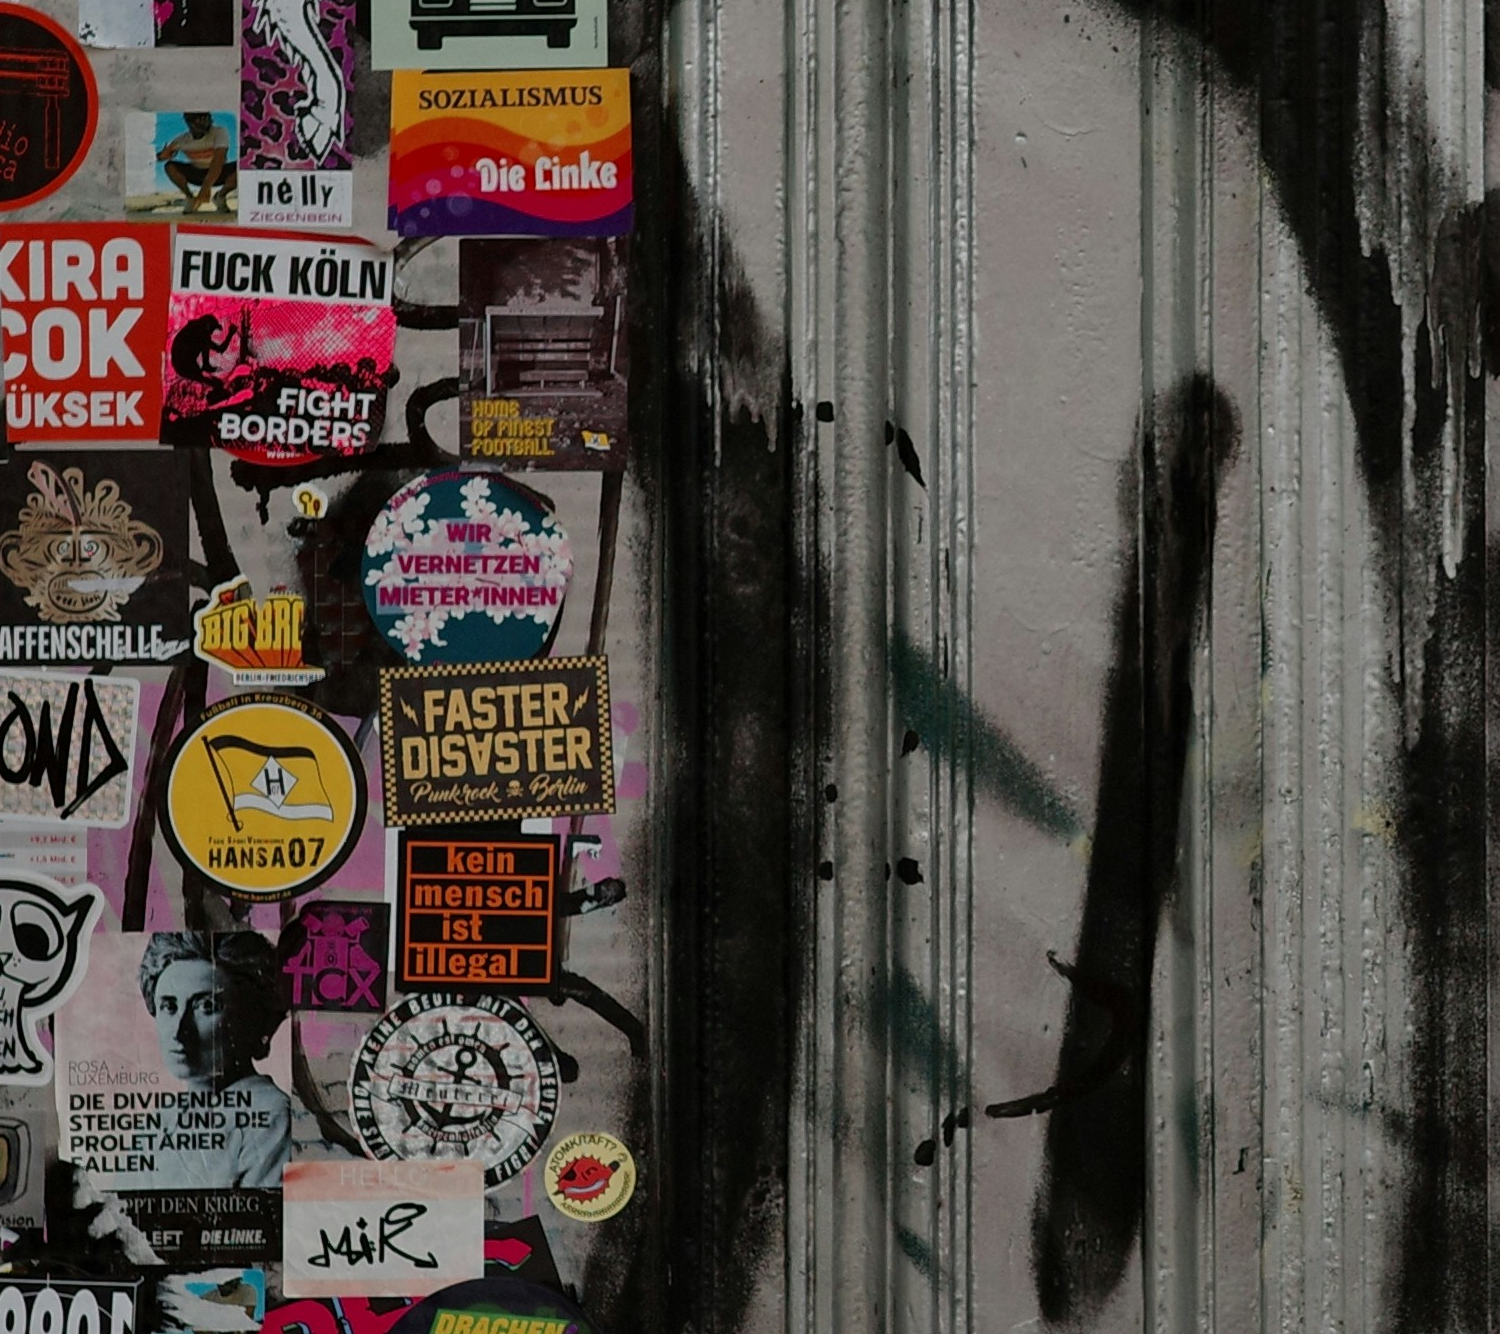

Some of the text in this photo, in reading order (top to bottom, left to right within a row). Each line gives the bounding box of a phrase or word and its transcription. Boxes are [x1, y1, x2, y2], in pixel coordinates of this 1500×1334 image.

[419, 86, 603, 110] SOZIALISMUS
[180, 248, 387, 299] FUCK KÖLN
[277, 389, 378, 419] FIGHT
[216, 412, 373, 446] BORDERS
[446, 523, 491, 544] WIR
[398, 554, 540, 575] VERNETZEN
[446, 848, 516, 875] kein
[414, 879, 544, 911] mensch
[441, 912, 484, 942] ist
[413, 946, 520, 979] illegal
[69, 1091, 253, 1111] DIE DIVIDENDEN
[69, 1112, 271, 1133] STEIGEN, UND DIE
[69, 1133, 226, 1153] PROLETARIER
[69, 1155, 160, 1173] FALLEN.
